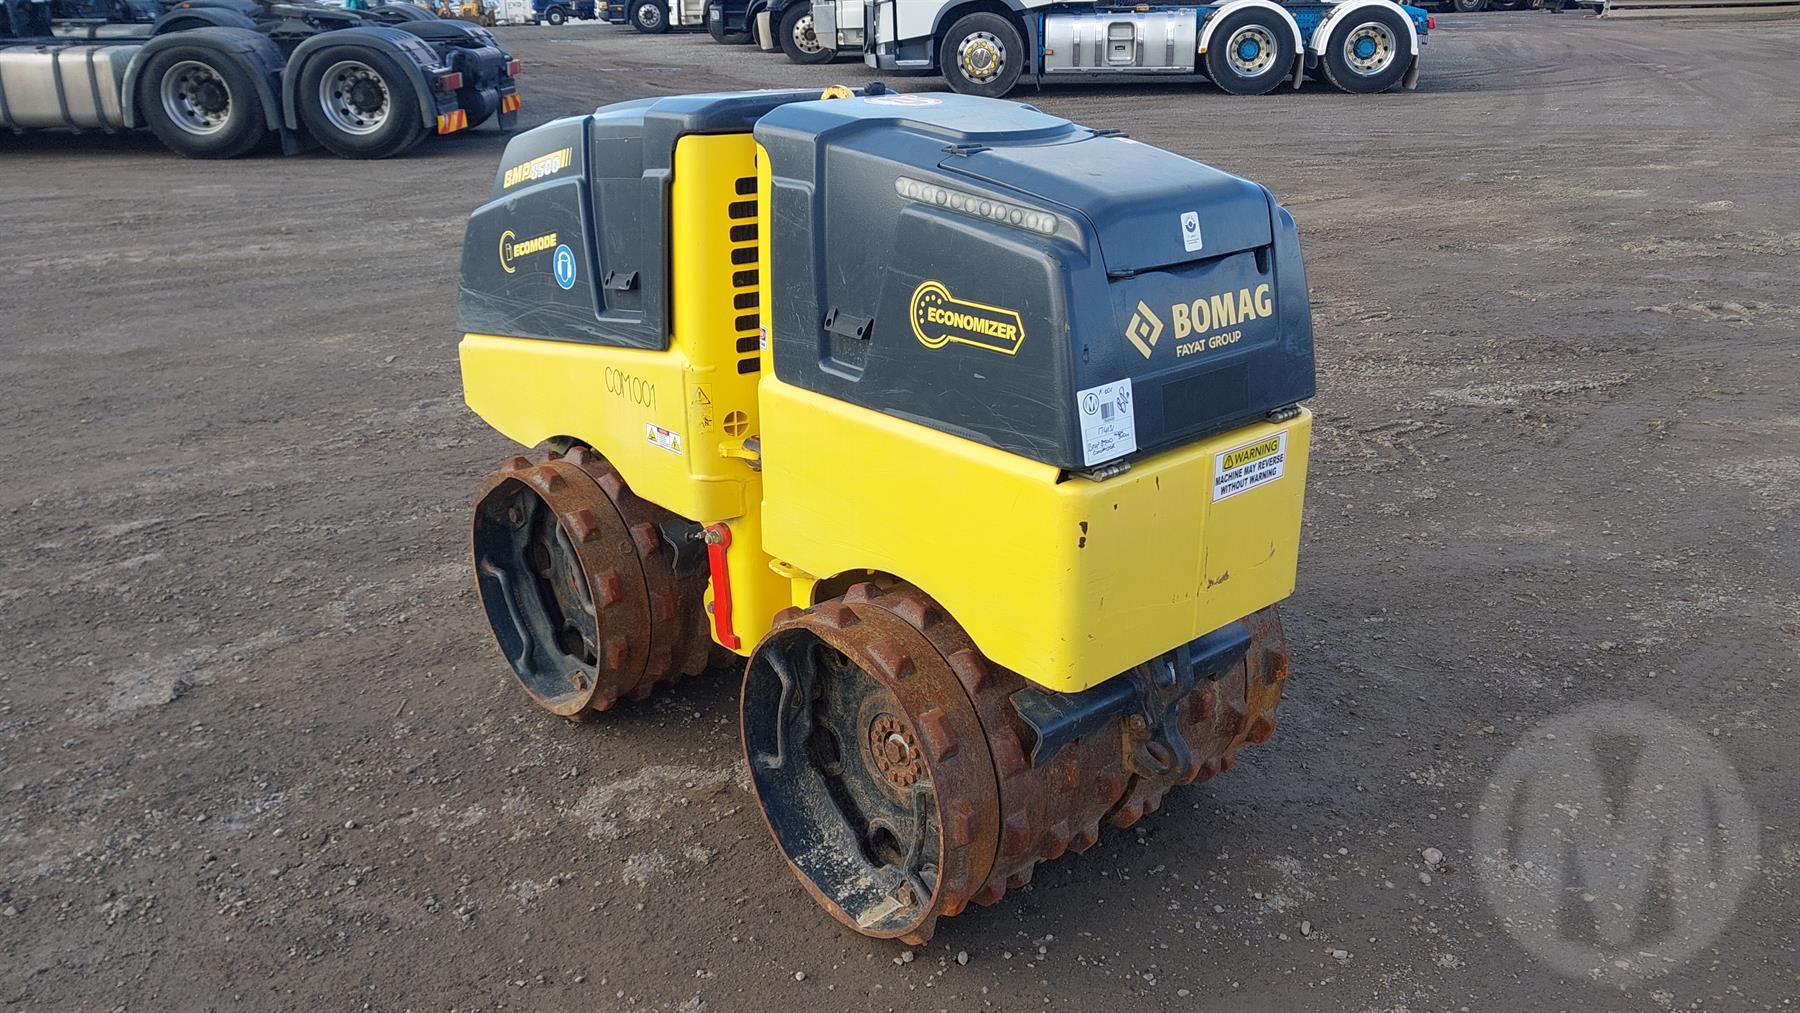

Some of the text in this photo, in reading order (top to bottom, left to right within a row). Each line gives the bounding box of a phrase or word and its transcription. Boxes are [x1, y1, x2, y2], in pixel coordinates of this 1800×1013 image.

[513, 232, 557, 258] ECOMODE
[927, 306, 1017, 341] ECONOMIZER
[1172, 283, 1273, 339] BOMAG
[1176, 330, 1242, 358] FAYAT GROUP
[1234, 440, 1278, 464] WARNING
[1215, 453, 1284, 486] MACHINE MAY REVERSE
[1220, 467, 1277, 495] WITHOUT WARNING
